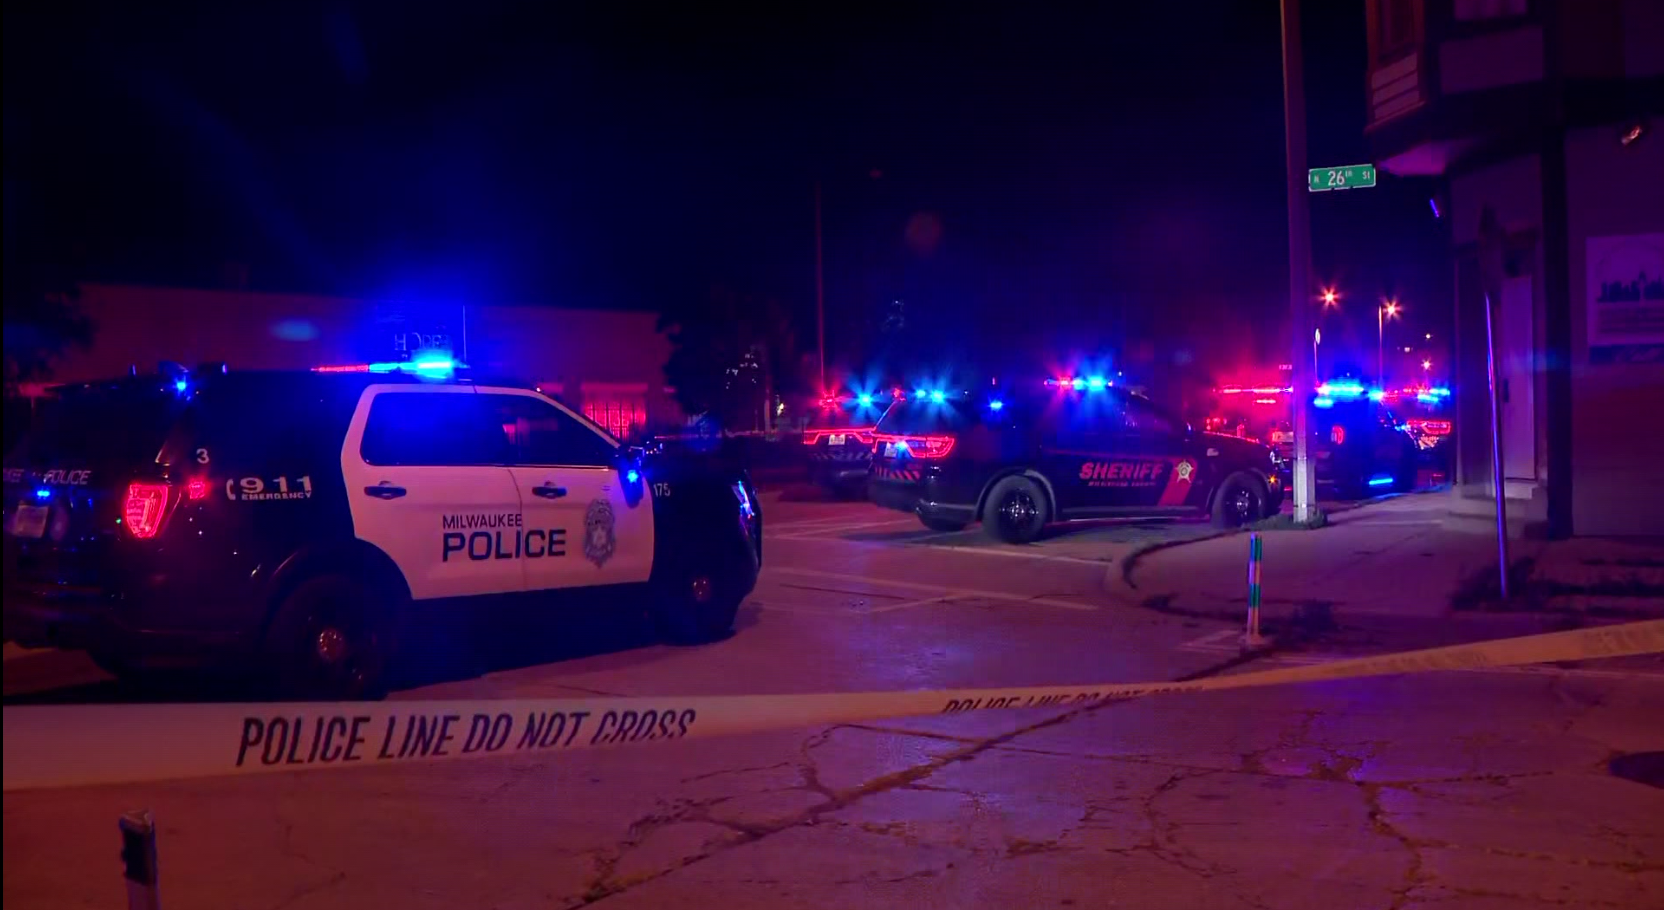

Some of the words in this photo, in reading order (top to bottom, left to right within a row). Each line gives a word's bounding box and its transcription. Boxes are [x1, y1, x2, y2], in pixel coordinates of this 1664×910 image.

[195, 447, 211, 464] 3
[1078, 461, 1165, 480] SHERIFF
[239, 475, 312, 493] 911
[652, 482, 671, 497] 175
[442, 513, 523, 530] MILWAUKEE
[442, 529, 567, 562] POLICE
[236, 715, 371, 767] POLICE
[379, 714, 460, 759] LINE
[462, 713, 513, 754] DO
[516, 711, 591, 749] NOT
[590, 709, 697, 745] CROSS
